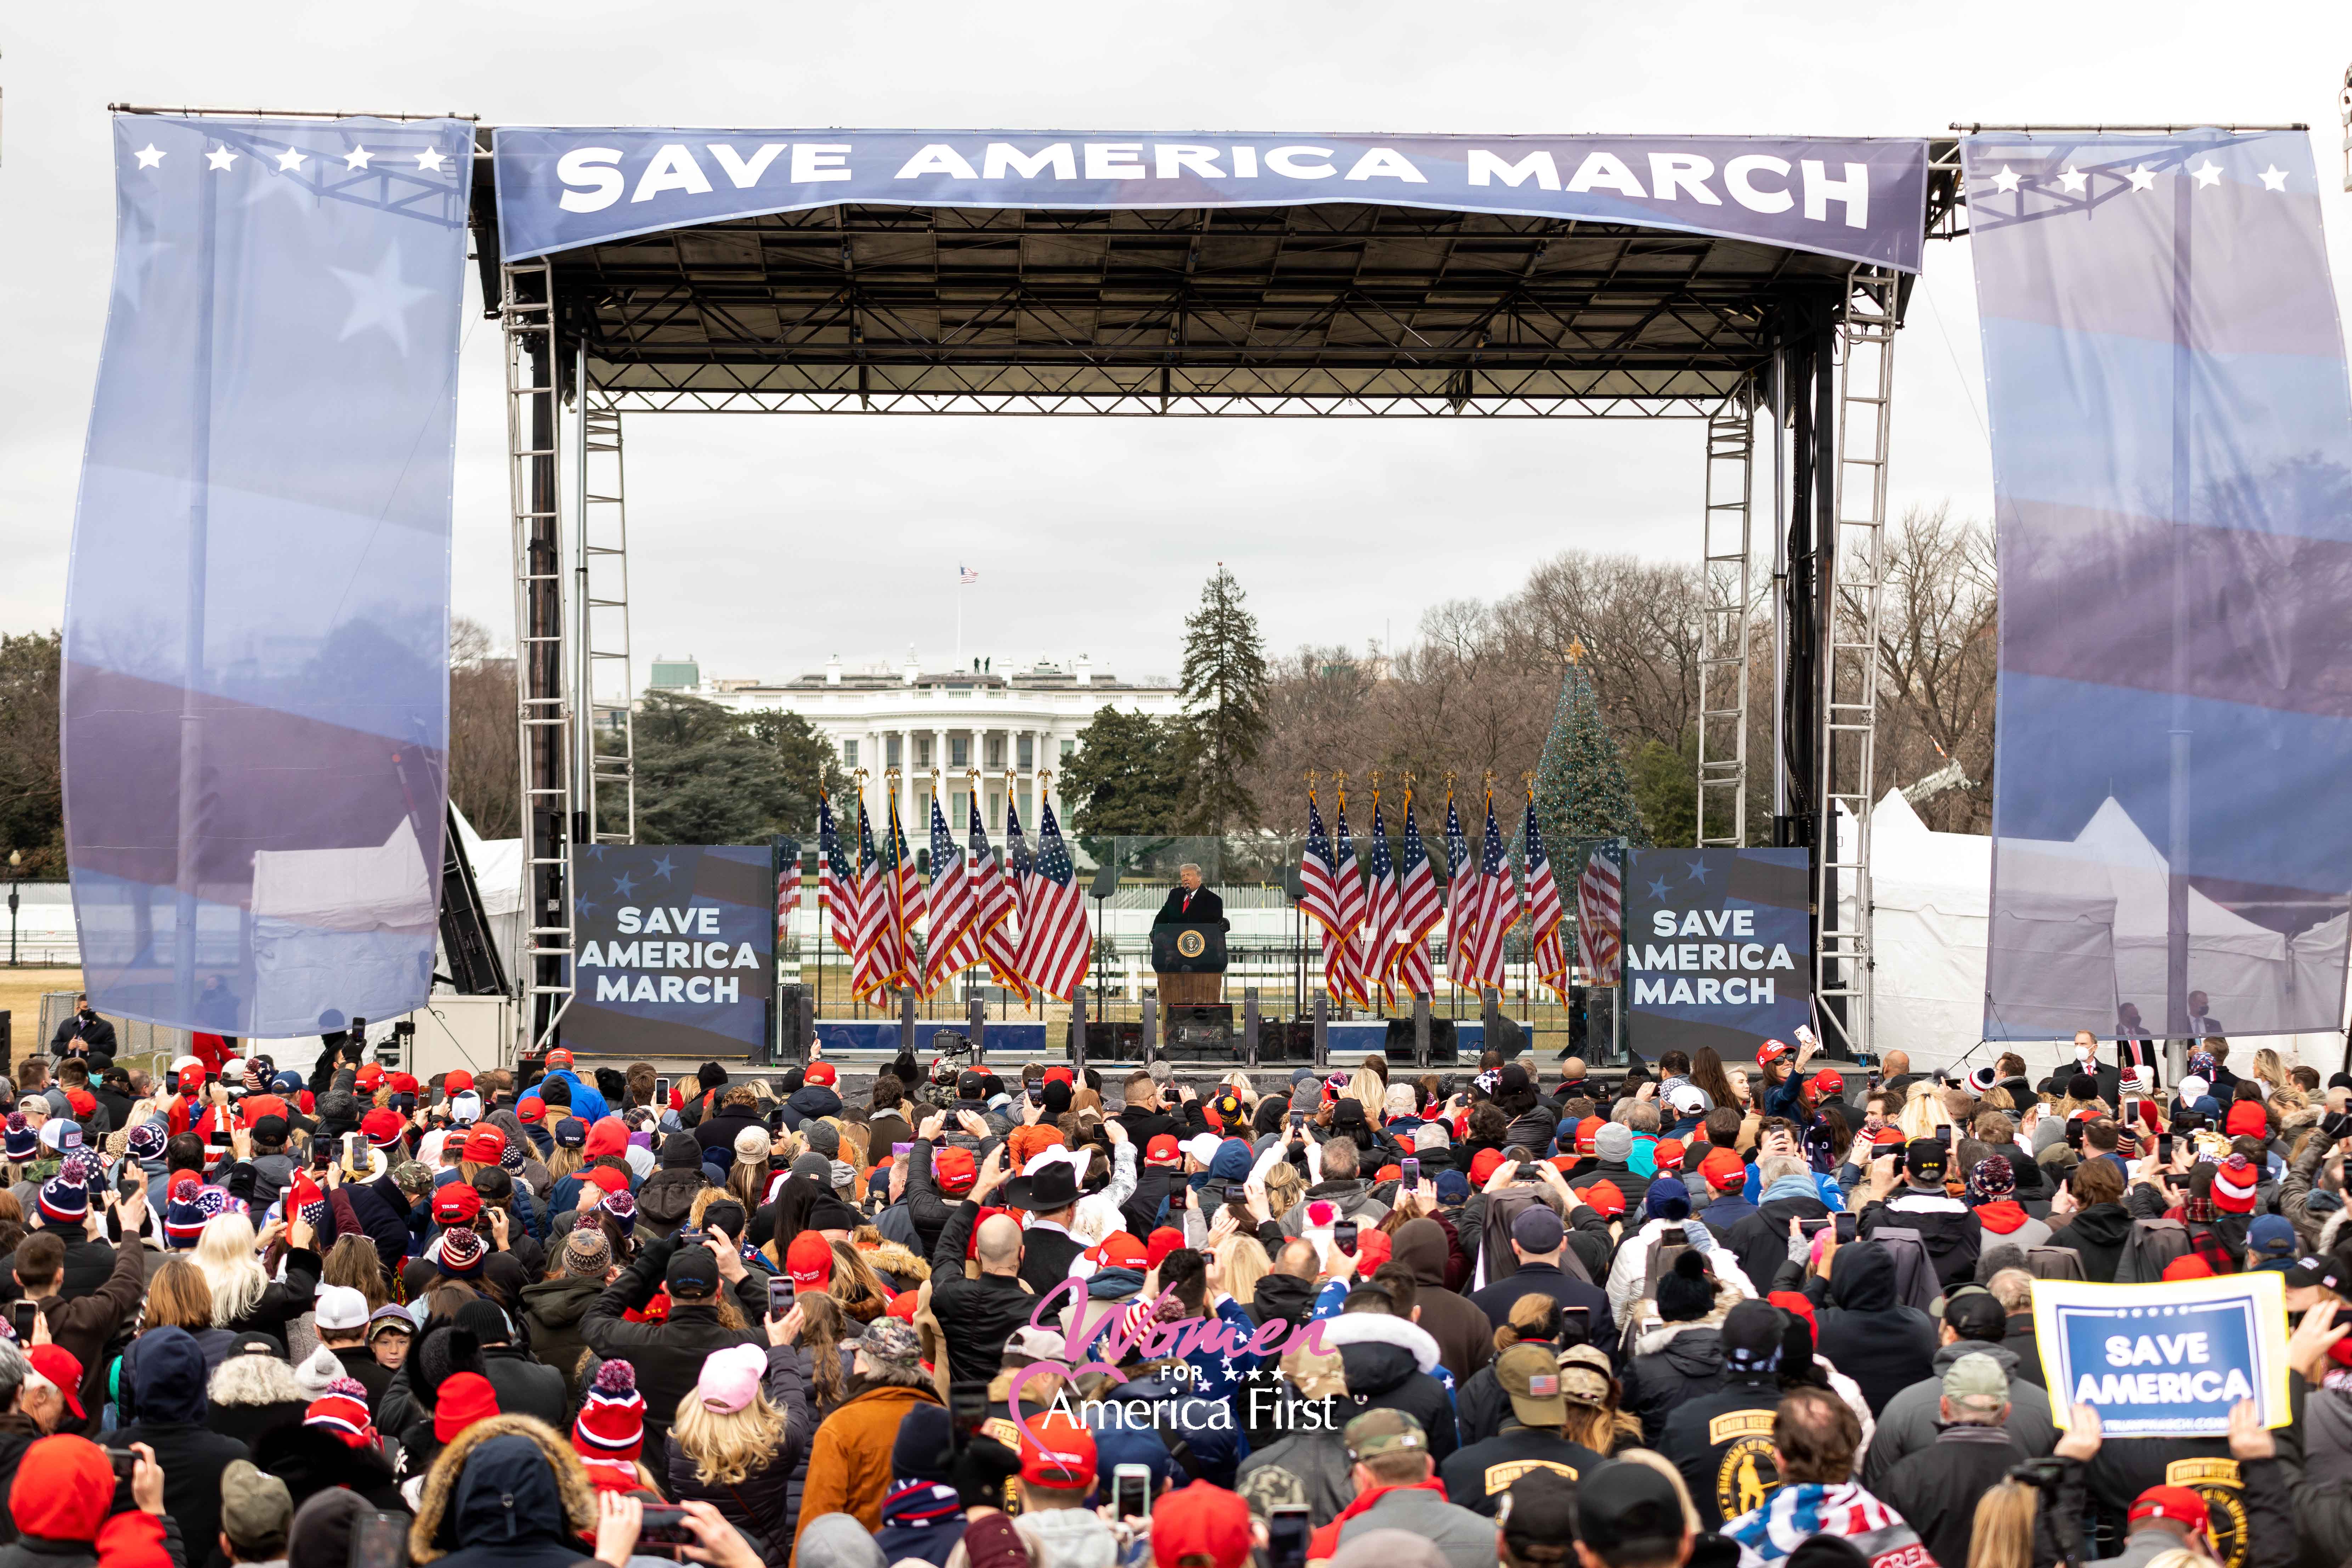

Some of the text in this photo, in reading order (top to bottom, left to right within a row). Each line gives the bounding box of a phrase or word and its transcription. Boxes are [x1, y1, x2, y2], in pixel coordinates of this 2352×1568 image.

[556, 142, 1869, 230] SAVE AMERICA MARCH
[617, 907, 720, 934] SAVE
[1653, 910, 1754, 937] SAVE
[577, 941, 759, 969] AMERICA
[1628, 944, 1795, 970] AMERICA
[597, 975, 739, 1003] MARCH
[1634, 978, 1775, 1004] MARCH
[2105, 1332, 2210, 1367] SAVE
[2075, 1368, 2253, 1405] AMERICA
